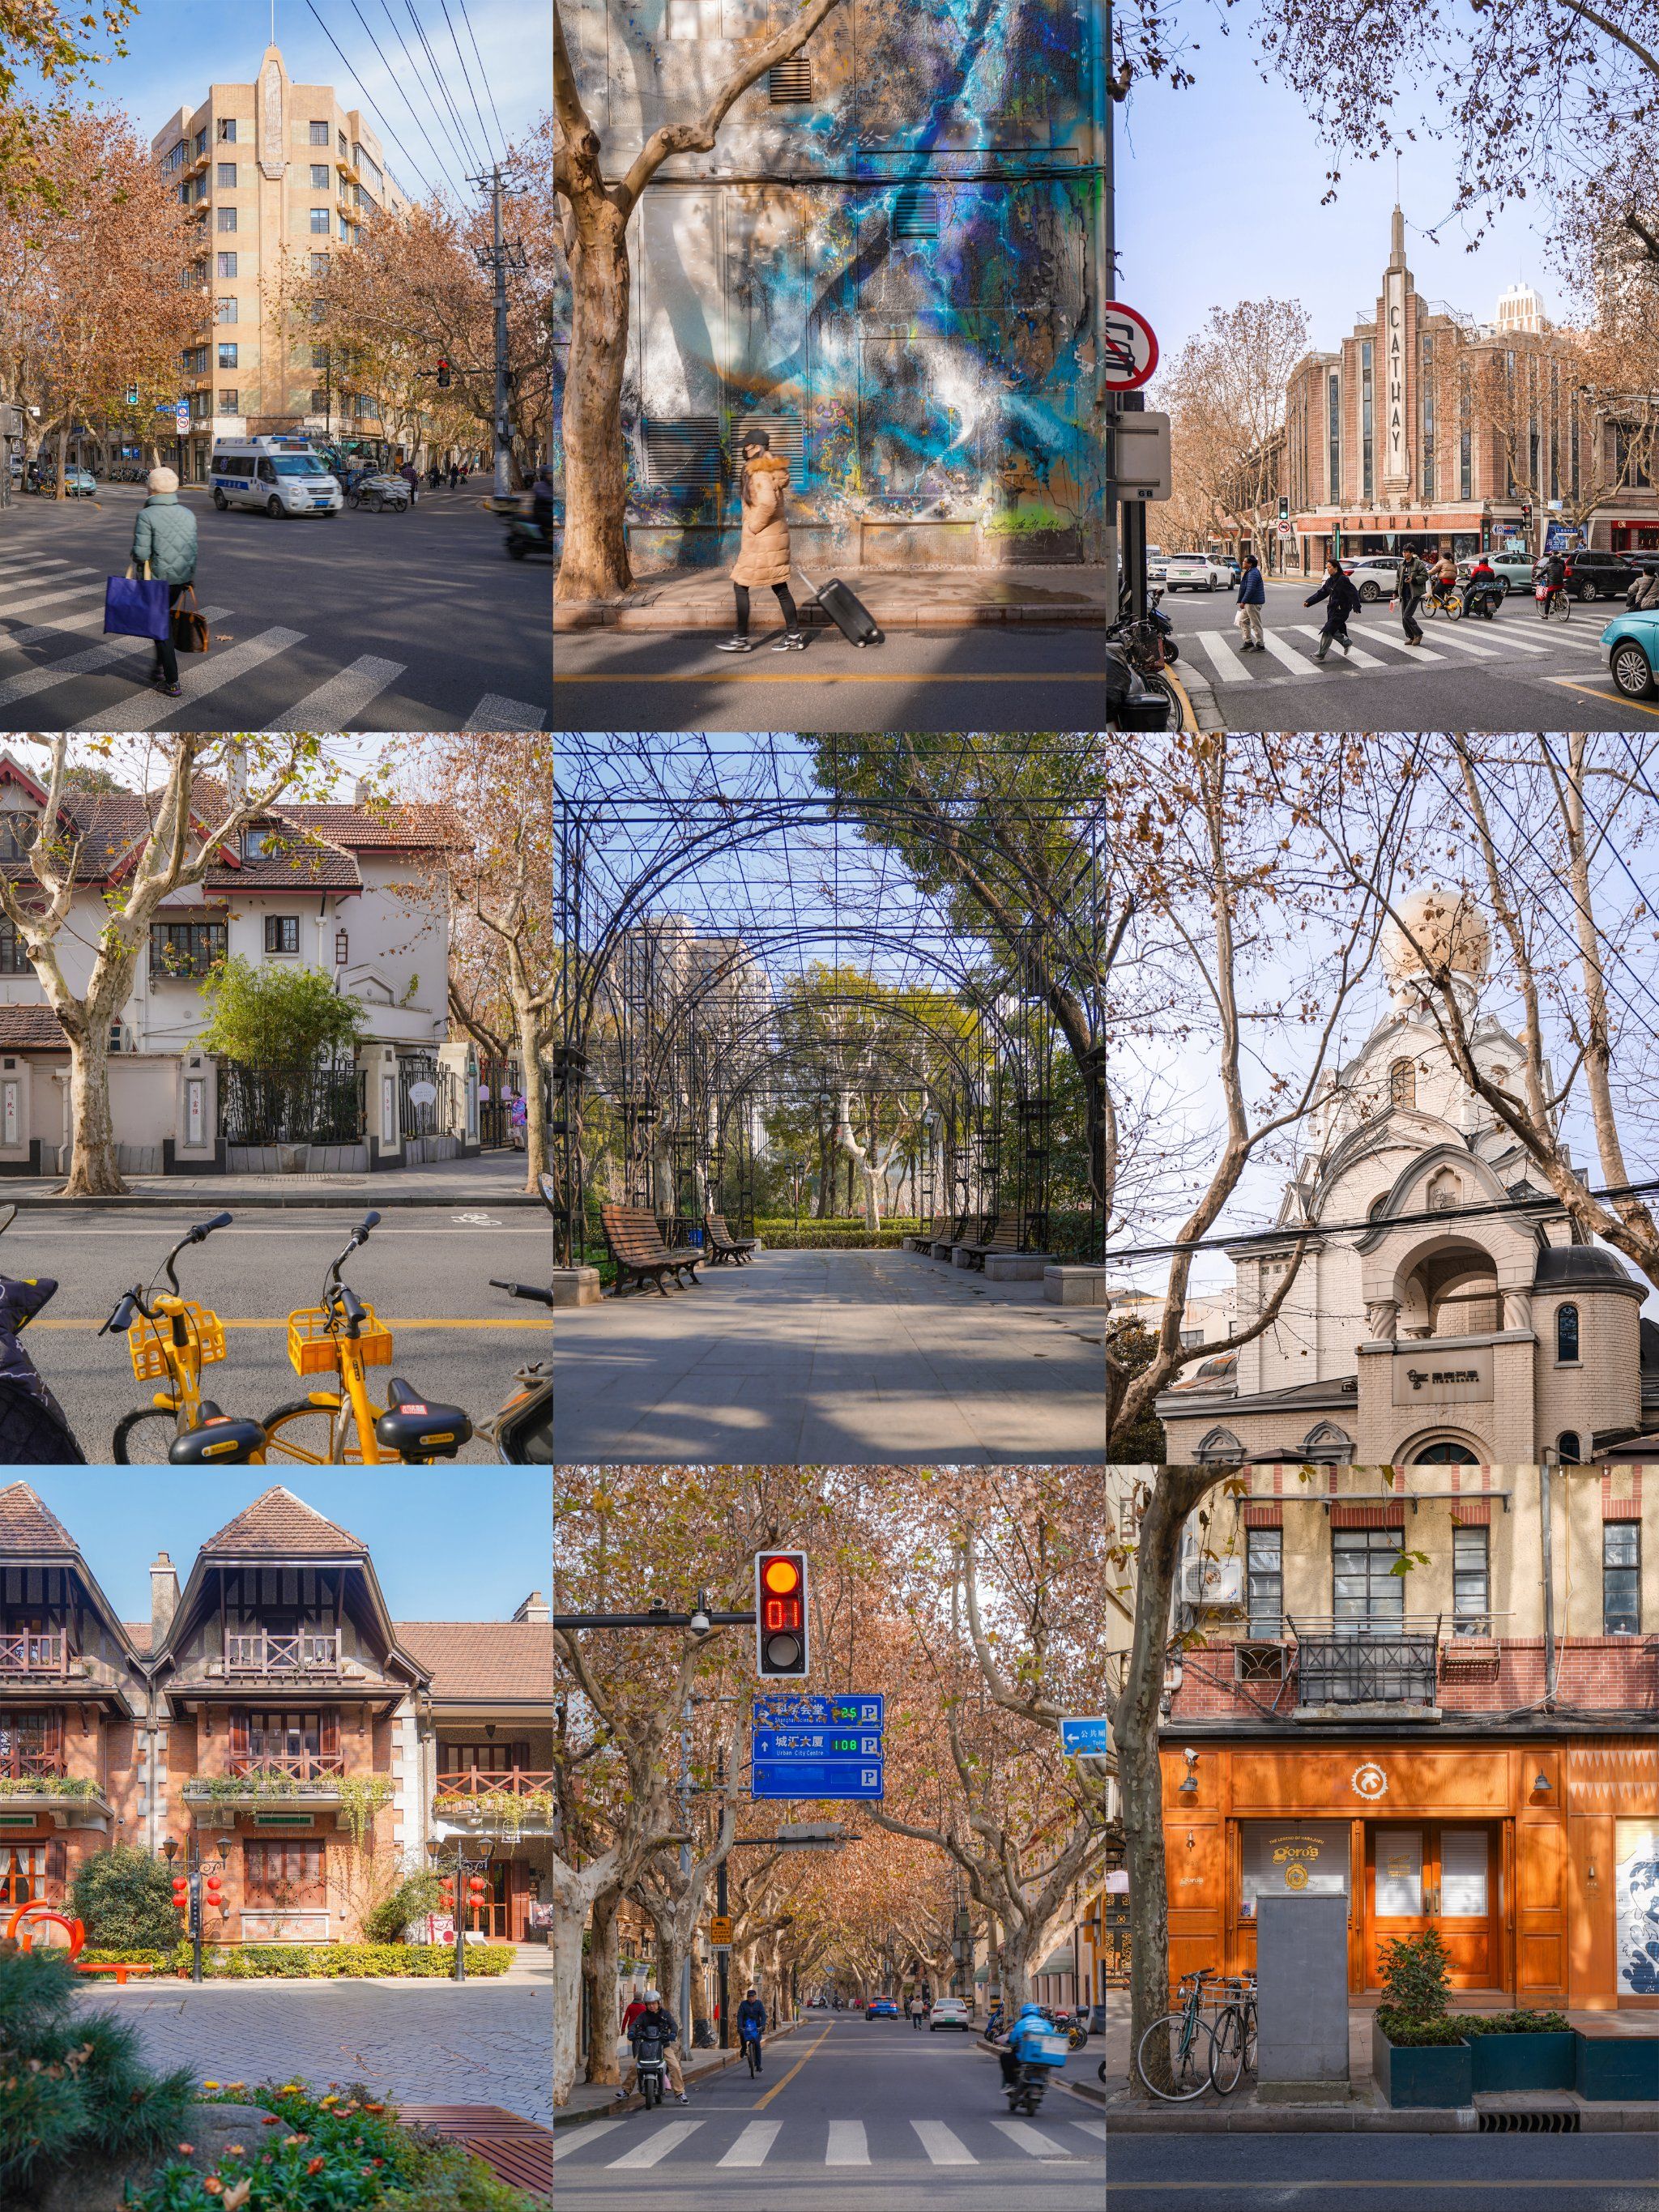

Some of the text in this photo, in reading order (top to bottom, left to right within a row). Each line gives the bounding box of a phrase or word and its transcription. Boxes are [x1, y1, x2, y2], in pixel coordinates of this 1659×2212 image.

[1390, 306, 1401, 451] CATHAY
[1342, 516, 1428, 531] CATHAY
[768, 1600, 798, 1628] 01
[775, 1736, 824, 1747] 城汇大厦
[834, 1740, 857, 1750] 108
[1273, 1845, 1319, 1864] goro's
